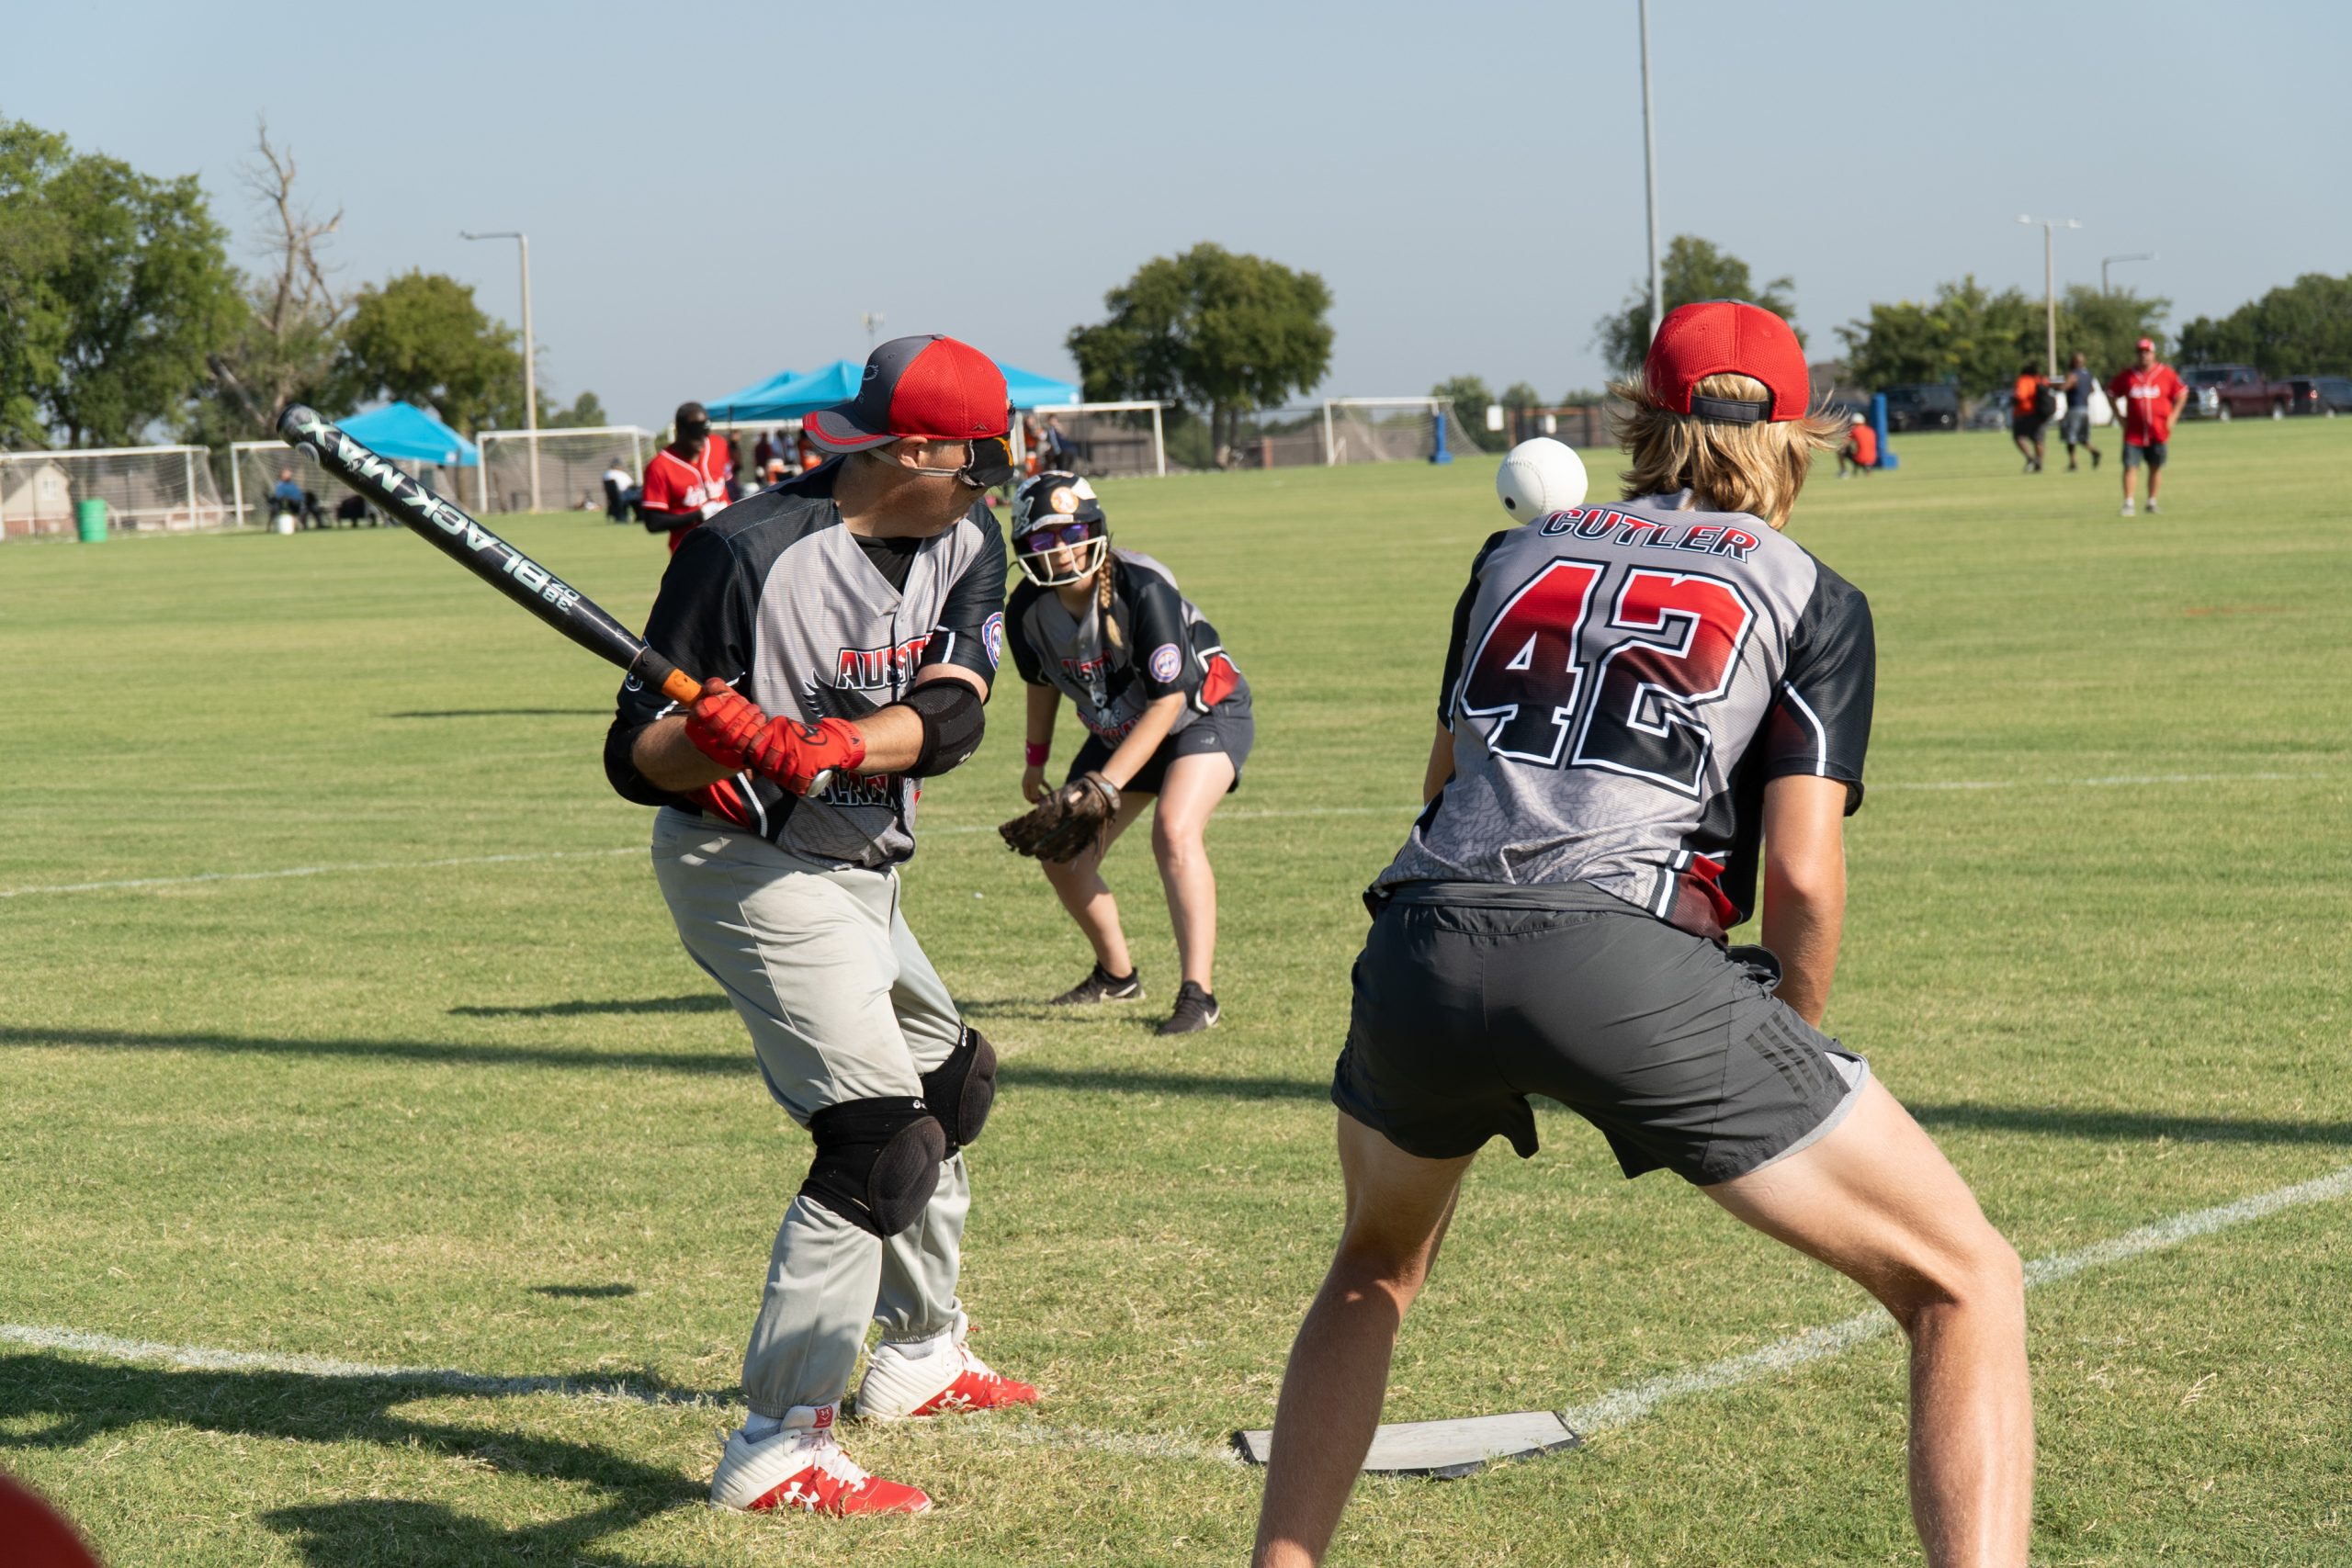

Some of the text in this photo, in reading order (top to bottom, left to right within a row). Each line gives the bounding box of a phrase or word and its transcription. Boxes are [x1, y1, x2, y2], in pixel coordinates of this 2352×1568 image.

[298, 414, 551, 593] BLACK MAX
[1539, 508, 1760, 562] CUTLER
[542, 587, 573, 615] 38
[551, 577, 581, 602] OZ
[833, 631, 934, 691] AUST
[1459, 556, 1758, 802] 42
